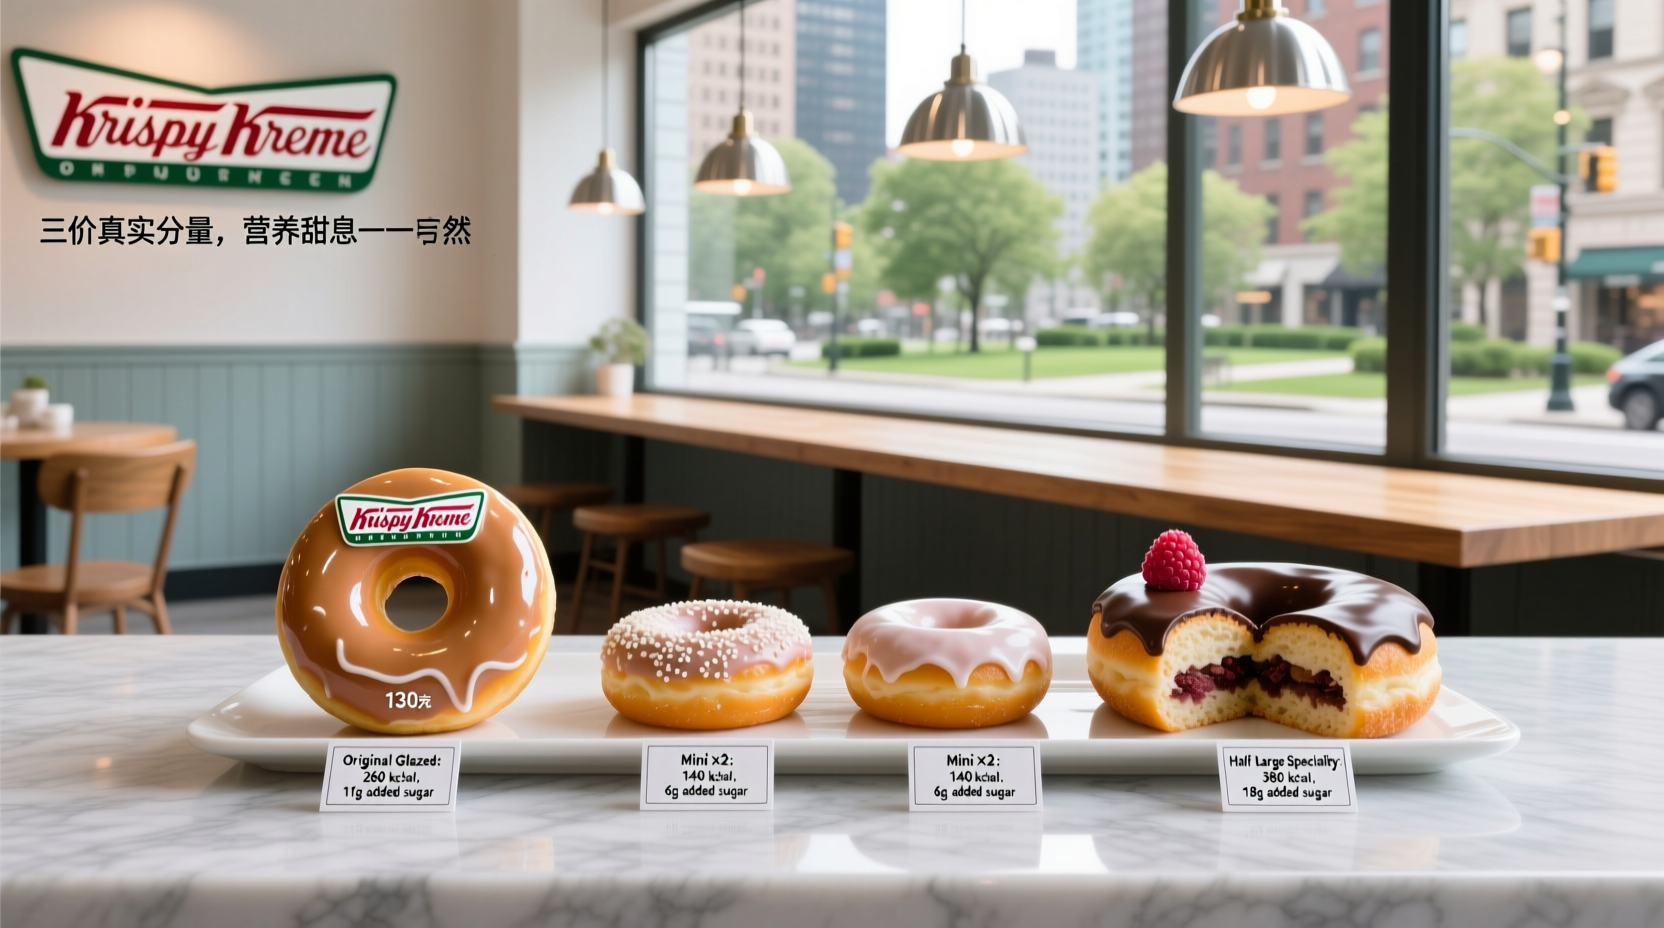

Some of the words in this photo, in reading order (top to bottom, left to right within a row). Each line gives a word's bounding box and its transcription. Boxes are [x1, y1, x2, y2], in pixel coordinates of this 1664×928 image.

[50, 91, 228, 162] Krispy
[220, 102, 377, 159] Kreme
[343, 753, 393, 770] Original
[395, 754, 442, 767] Glazed:
[681, 752, 708, 766] Mini
[946, 753, 974, 767] Mini
[1229, 754, 1252, 768] Half
[1255, 755, 1285, 771] Large
[362, 770, 386, 783] 260
[682, 769, 705, 782] 140
[949, 770, 973, 783] 140
[366, 785, 400, 798] added
[403, 788, 434, 801] sugar
[664, 784, 679, 800] 6g
[682, 784, 716, 796] added
[718, 787, 748, 800] sugar
[933, 785, 948, 801] 6g
[951, 784, 983, 797] added
[985, 788, 1016, 801] sugar
[1242, 786, 1264, 801] 18g
[1266, 785, 1299, 798] added
[1302, 788, 1332, 801] sugar
